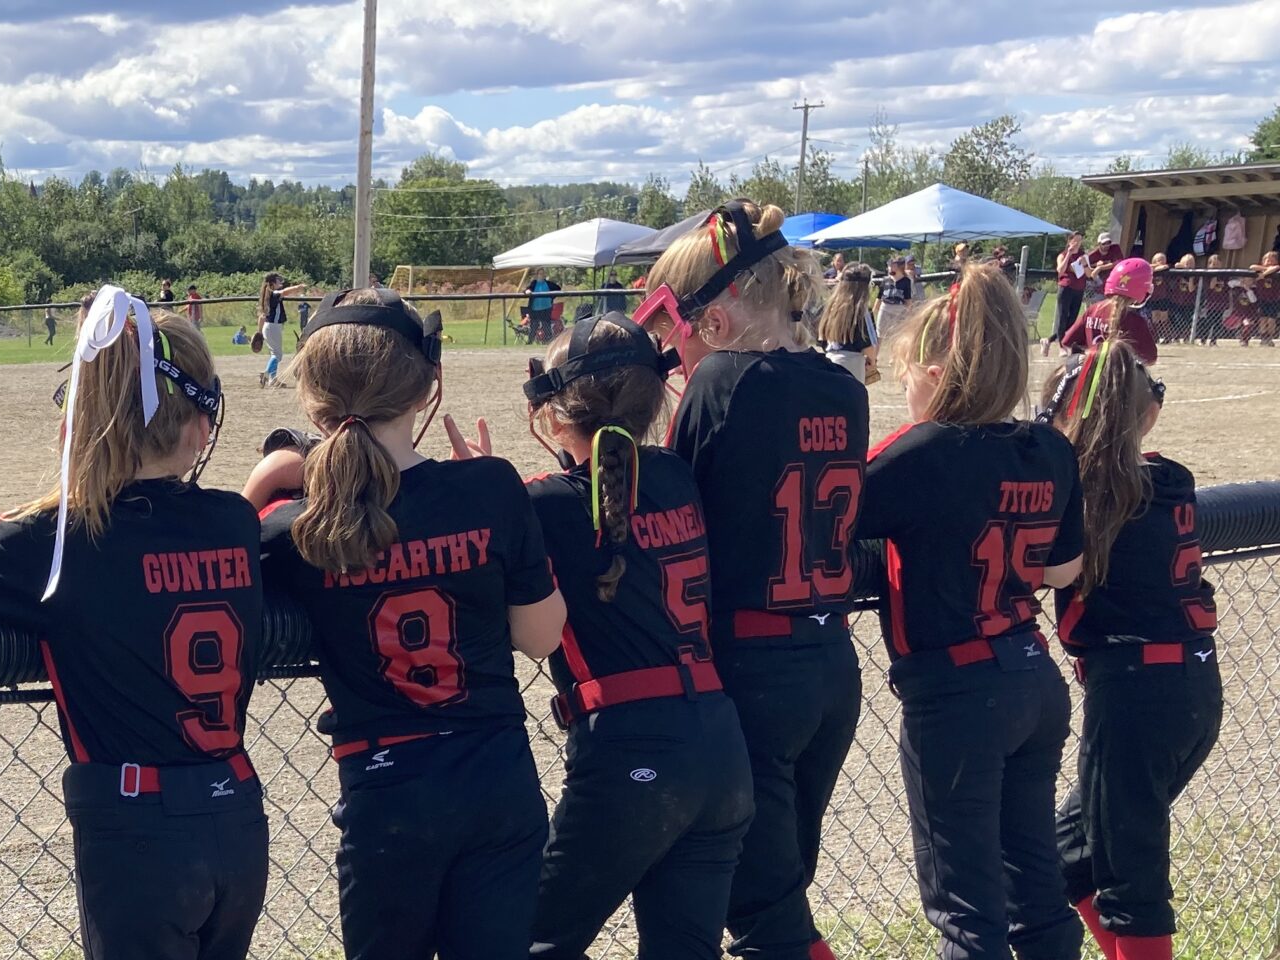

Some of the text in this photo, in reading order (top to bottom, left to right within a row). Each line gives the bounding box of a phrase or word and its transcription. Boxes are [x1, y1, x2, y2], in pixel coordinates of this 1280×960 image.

[799, 416, 847, 452] COES
[767, 461, 863, 609] 13
[999, 480, 1055, 513] TITUS
[143, 547, 252, 593] GUNTER
[658, 547, 713, 665] 5
[163, 601, 245, 757] 9
[368, 586, 468, 707] 8
